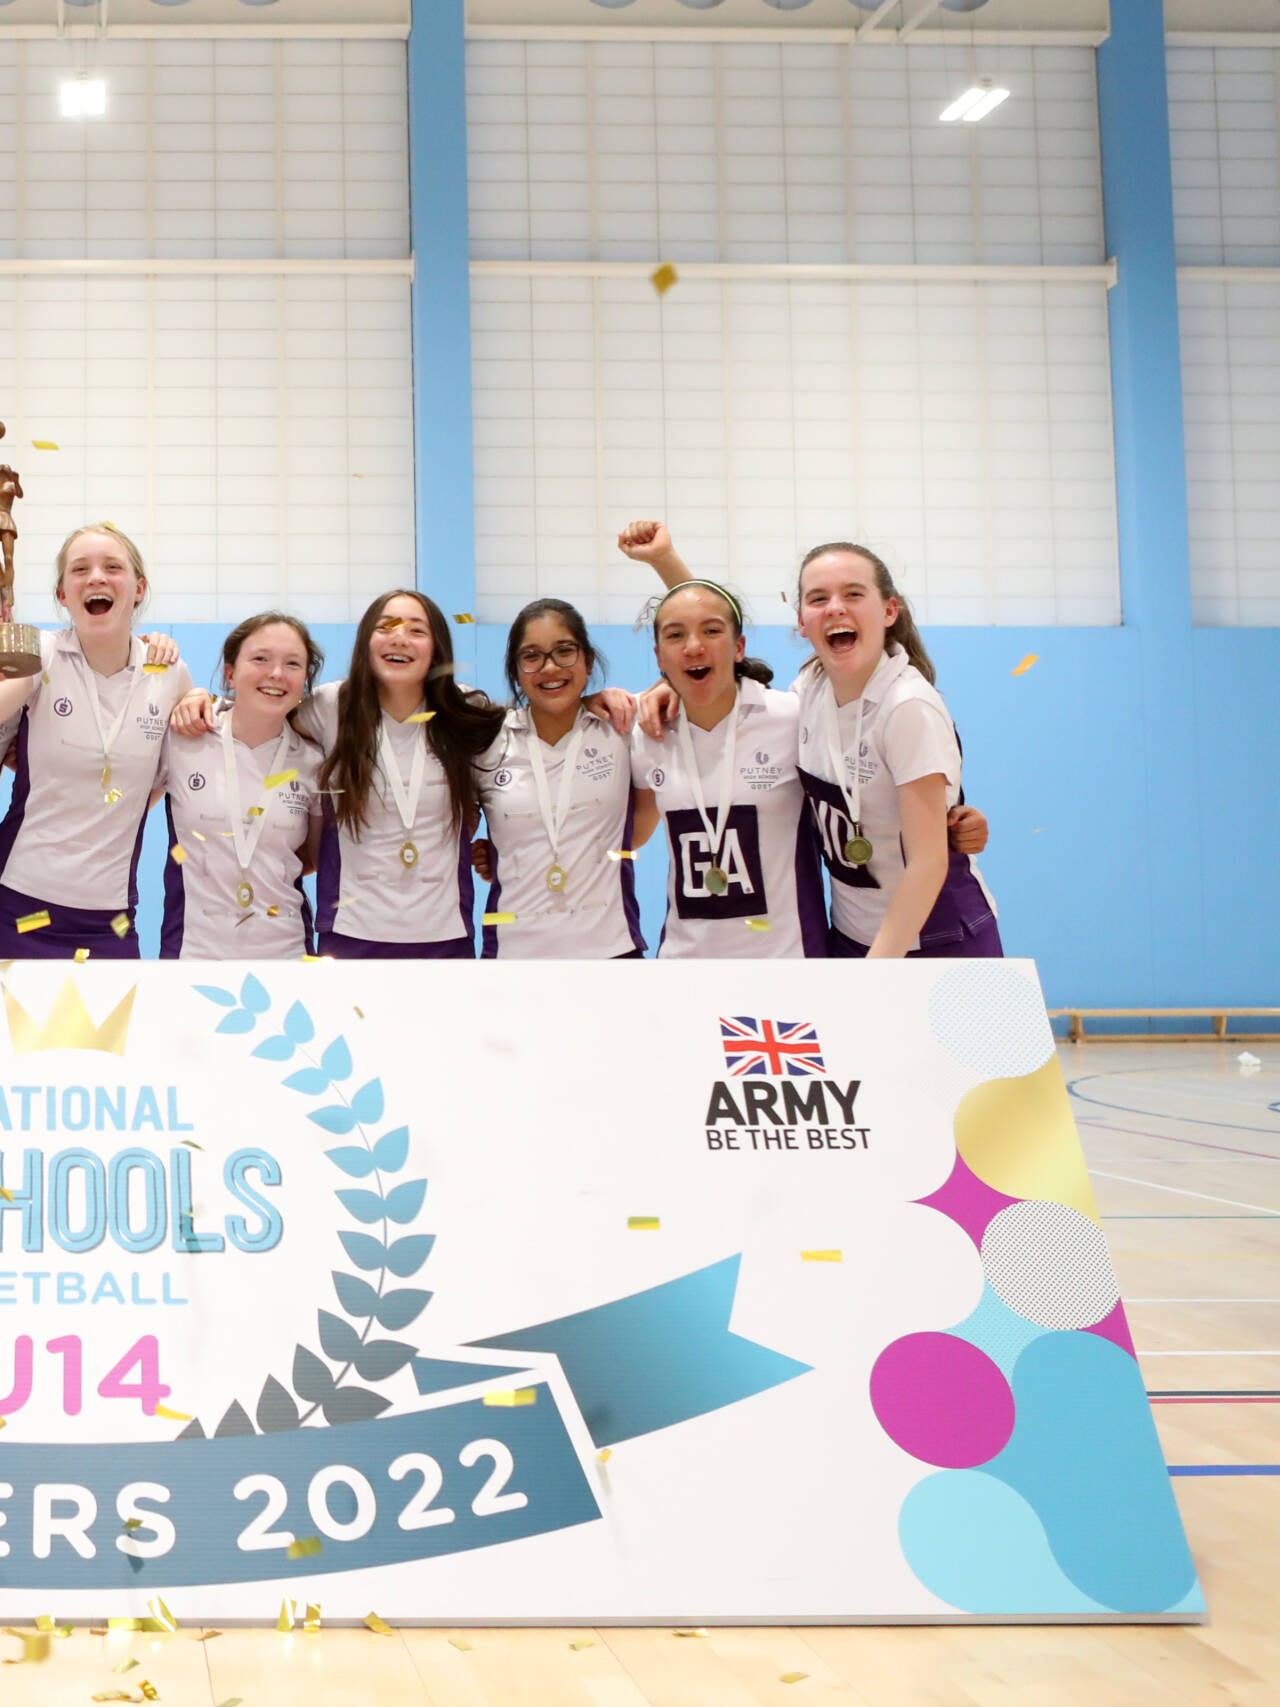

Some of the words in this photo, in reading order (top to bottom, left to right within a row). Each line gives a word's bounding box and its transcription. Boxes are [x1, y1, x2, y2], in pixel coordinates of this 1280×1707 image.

[740, 767, 782, 775] PUTNEY
[679, 828, 755, 898] GA
[705, 1080, 862, 1126] ARMY
[706, 1129, 740, 1150] BE
[745, 1129, 799, 1150] THE
[806, 1128, 871, 1150] BEST
[233, 1438, 529, 1552] 2022
